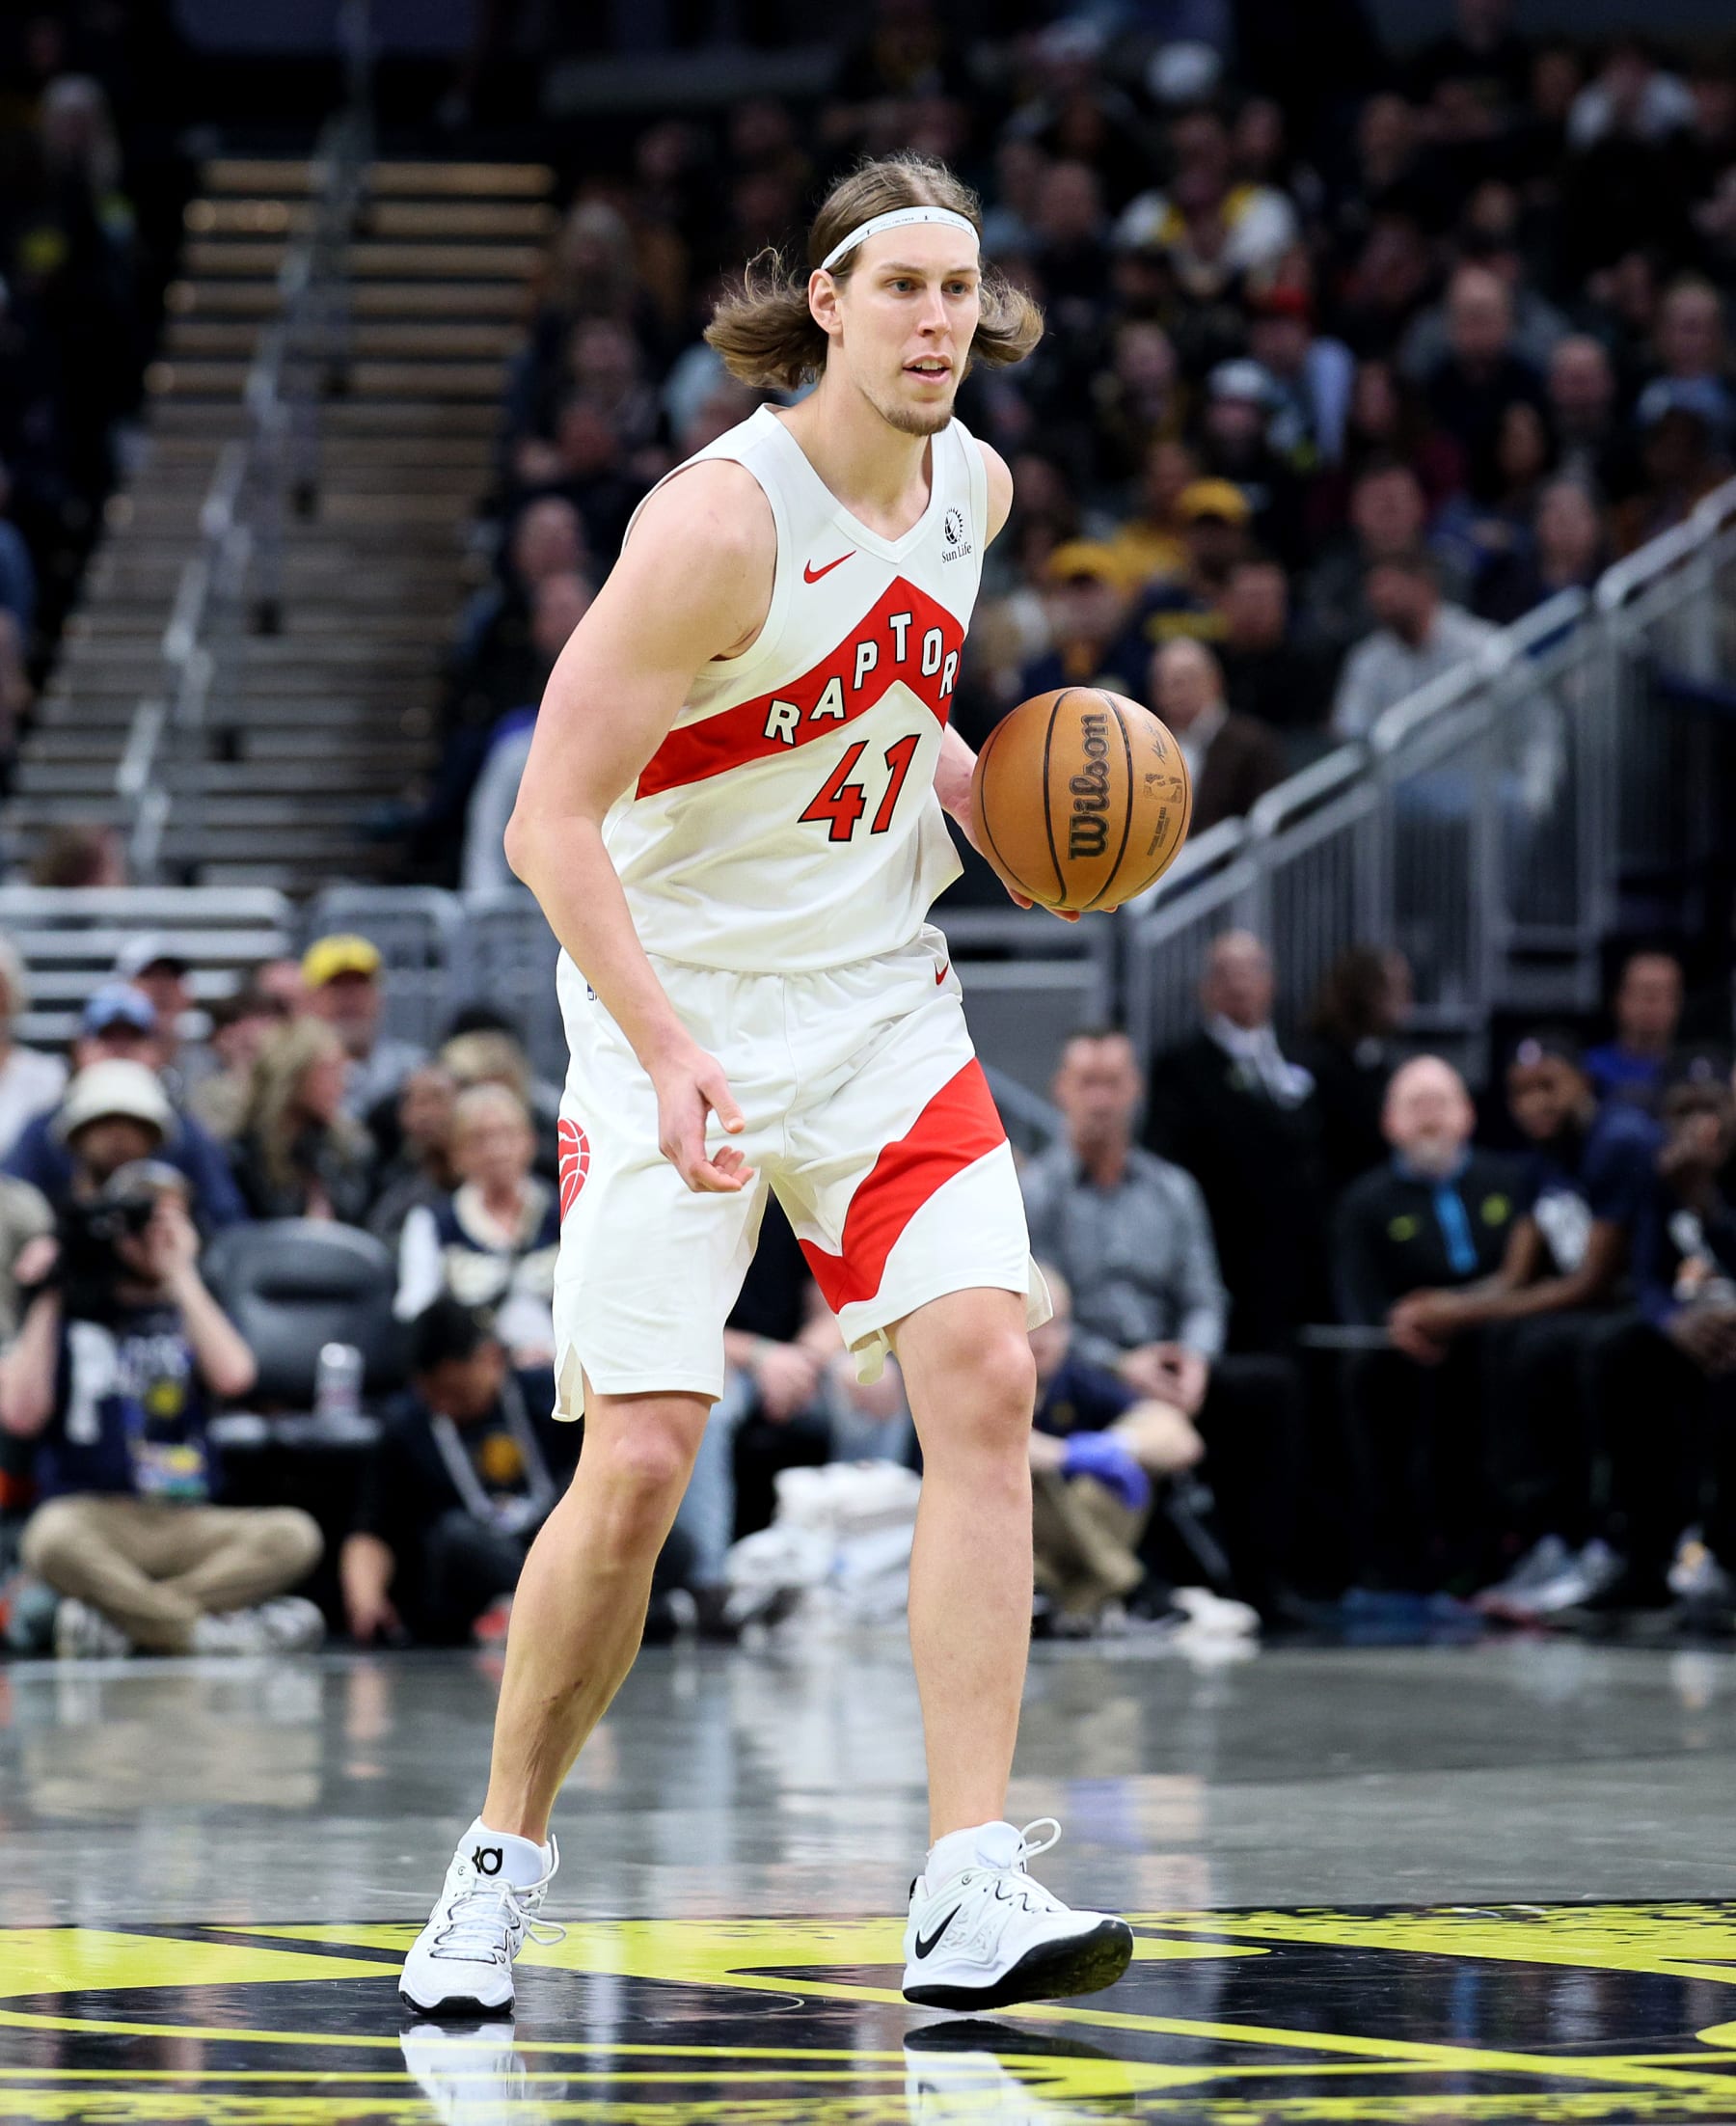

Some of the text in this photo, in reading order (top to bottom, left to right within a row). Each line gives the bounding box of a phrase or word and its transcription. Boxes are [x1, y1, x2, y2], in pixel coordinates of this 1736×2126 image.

[941, 541, 972, 564] Sun Life
[797, 733, 922, 843] 41
[1069, 713, 1111, 860] Wilson
